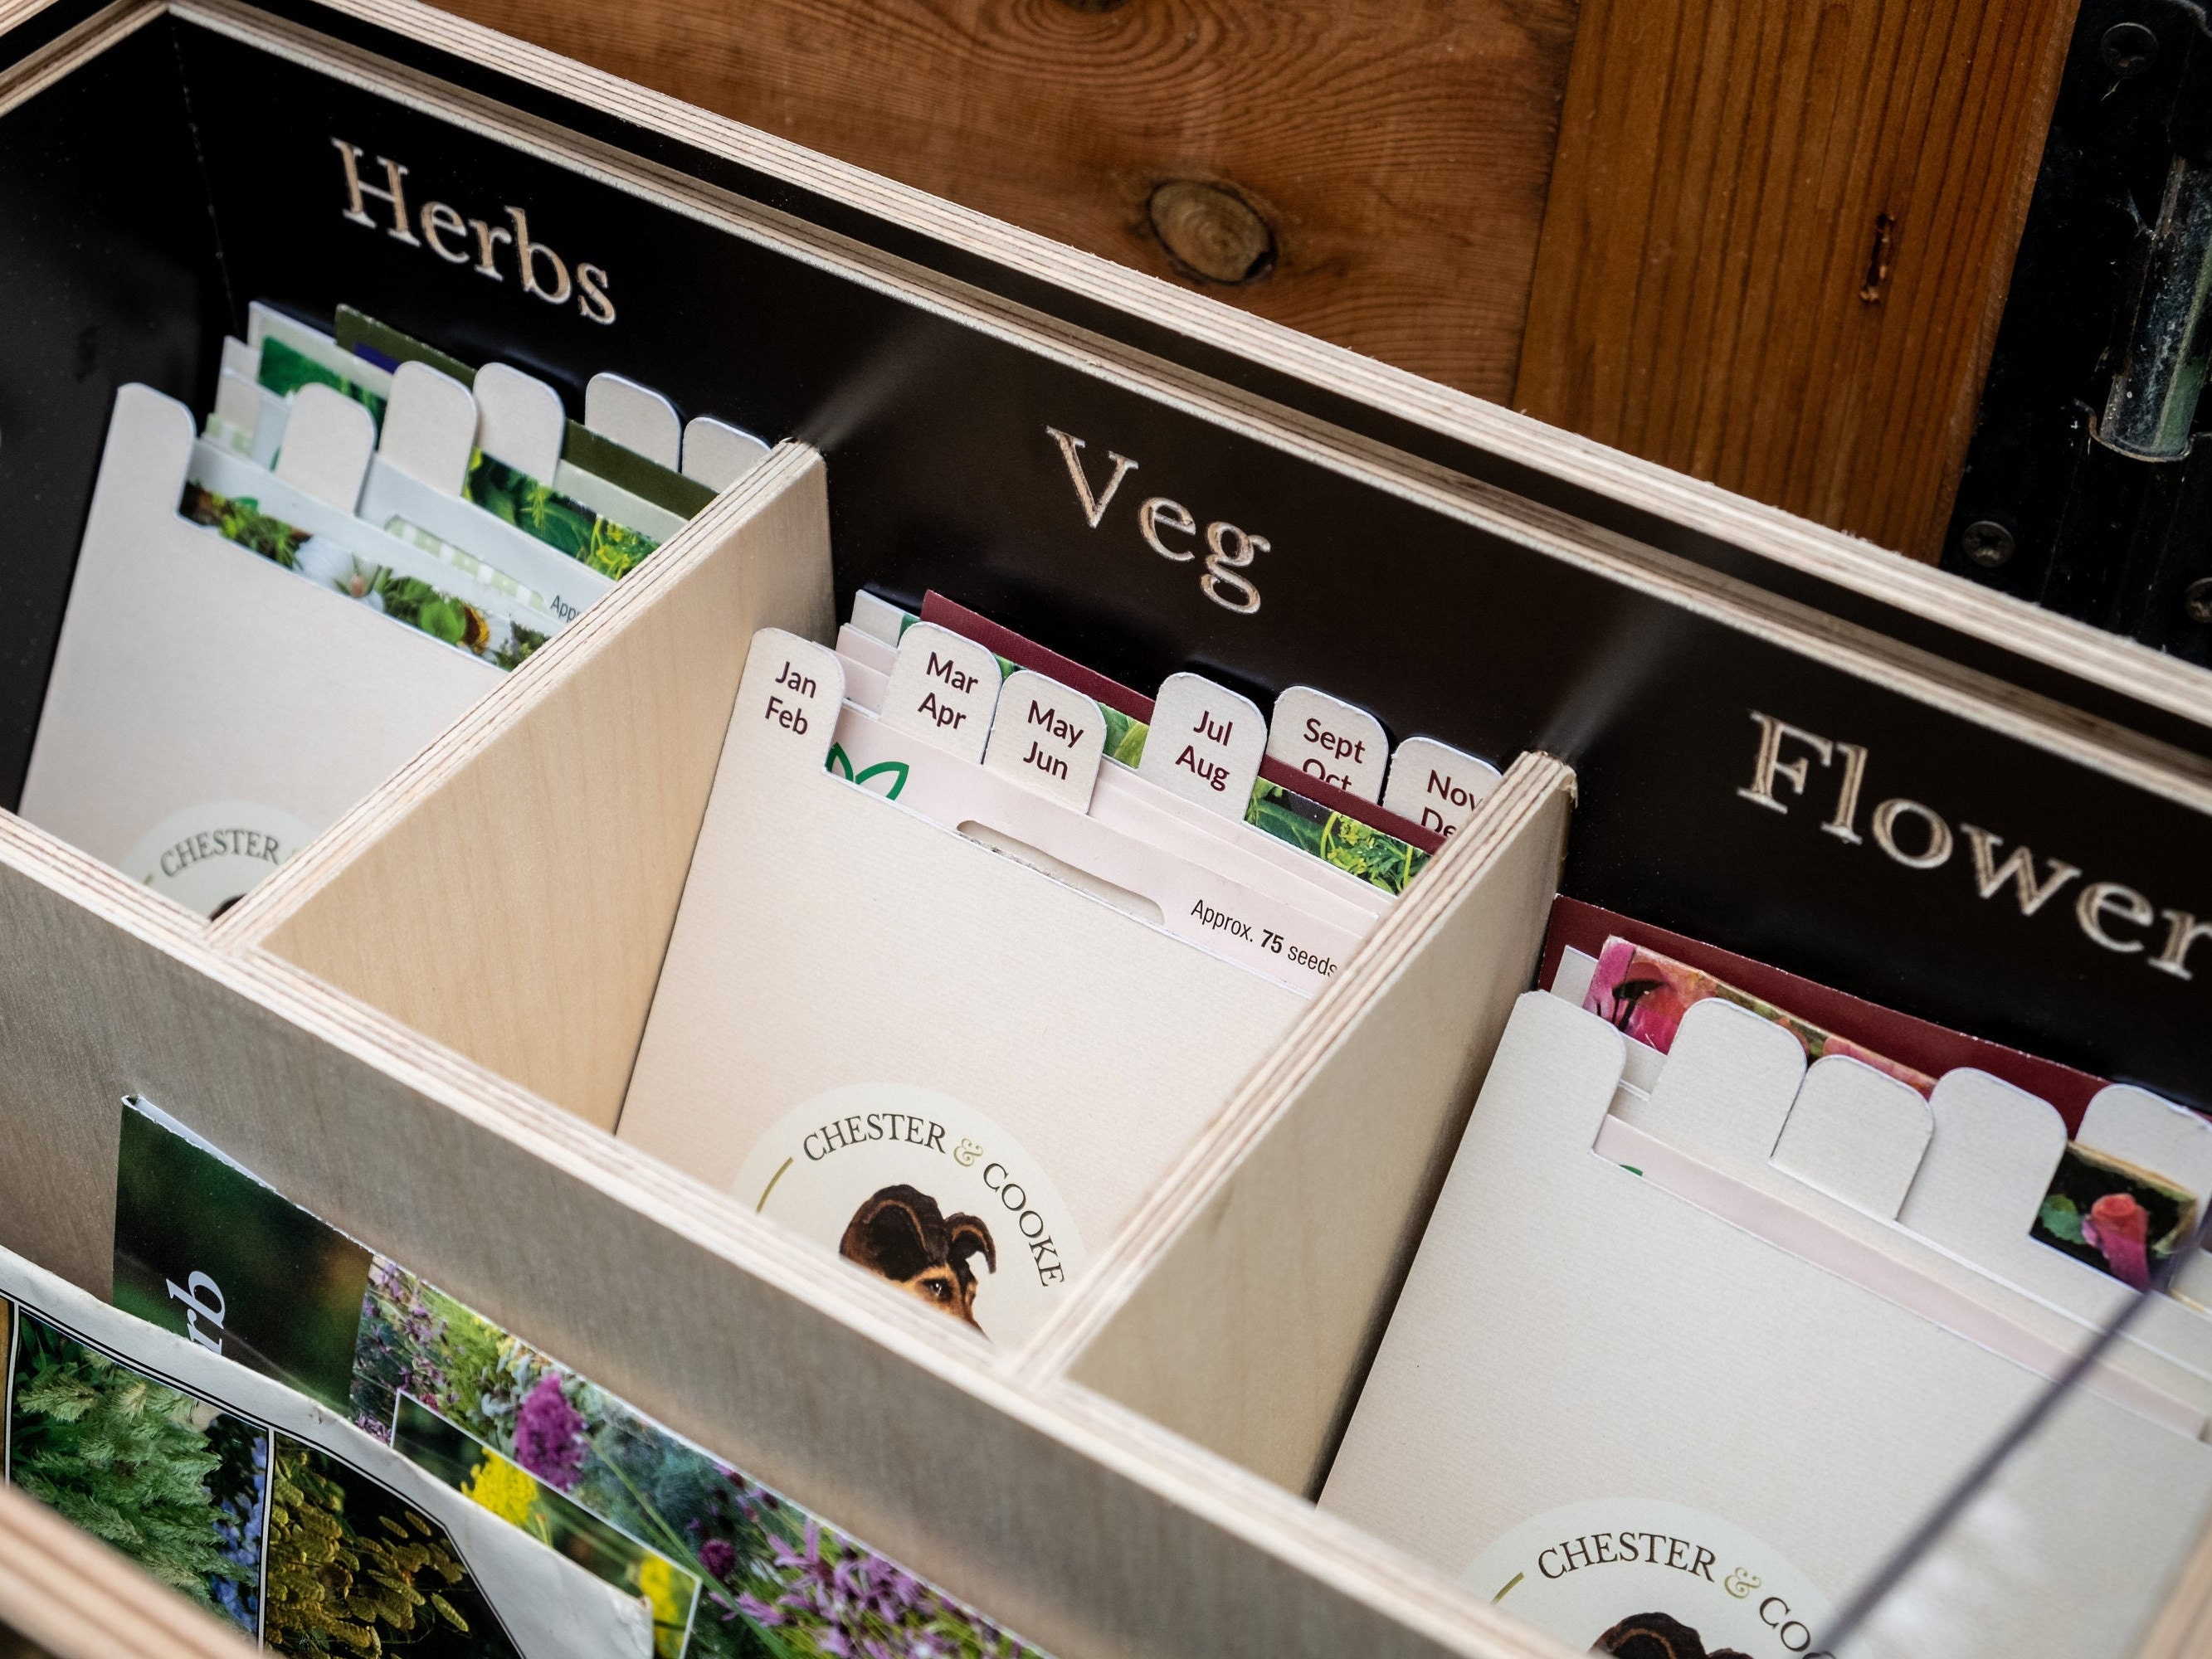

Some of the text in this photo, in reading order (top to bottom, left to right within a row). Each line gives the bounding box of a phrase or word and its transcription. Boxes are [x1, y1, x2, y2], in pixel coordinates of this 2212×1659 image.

[330, 135, 616, 325] Herbs
[1042, 425, 1271, 614] Veg
[775, 661, 816, 698] Jan
[926, 651, 978, 694] Mar
[764, 695, 808, 735] Feb
[917, 692, 967, 730] Apr
[1027, 699, 1084, 748] May
[1192, 709, 1234, 747] Jul
[1023, 741, 1069, 781] Jun
[1303, 718, 1367, 764] Sept
[1175, 745, 1230, 792] Aug
[1427, 769, 1484, 812] Nov
[1420, 806, 1458, 838] De
[160, 828, 280, 878] CHESTER
[1190, 898, 1338, 978] Approx. 75 seeds
[802, 1112, 1065, 1287] CHESTER & COOKE
[166, 1270, 226, 1356] rb
[1537, 1531, 1837, 1659] CHESTER & CO
